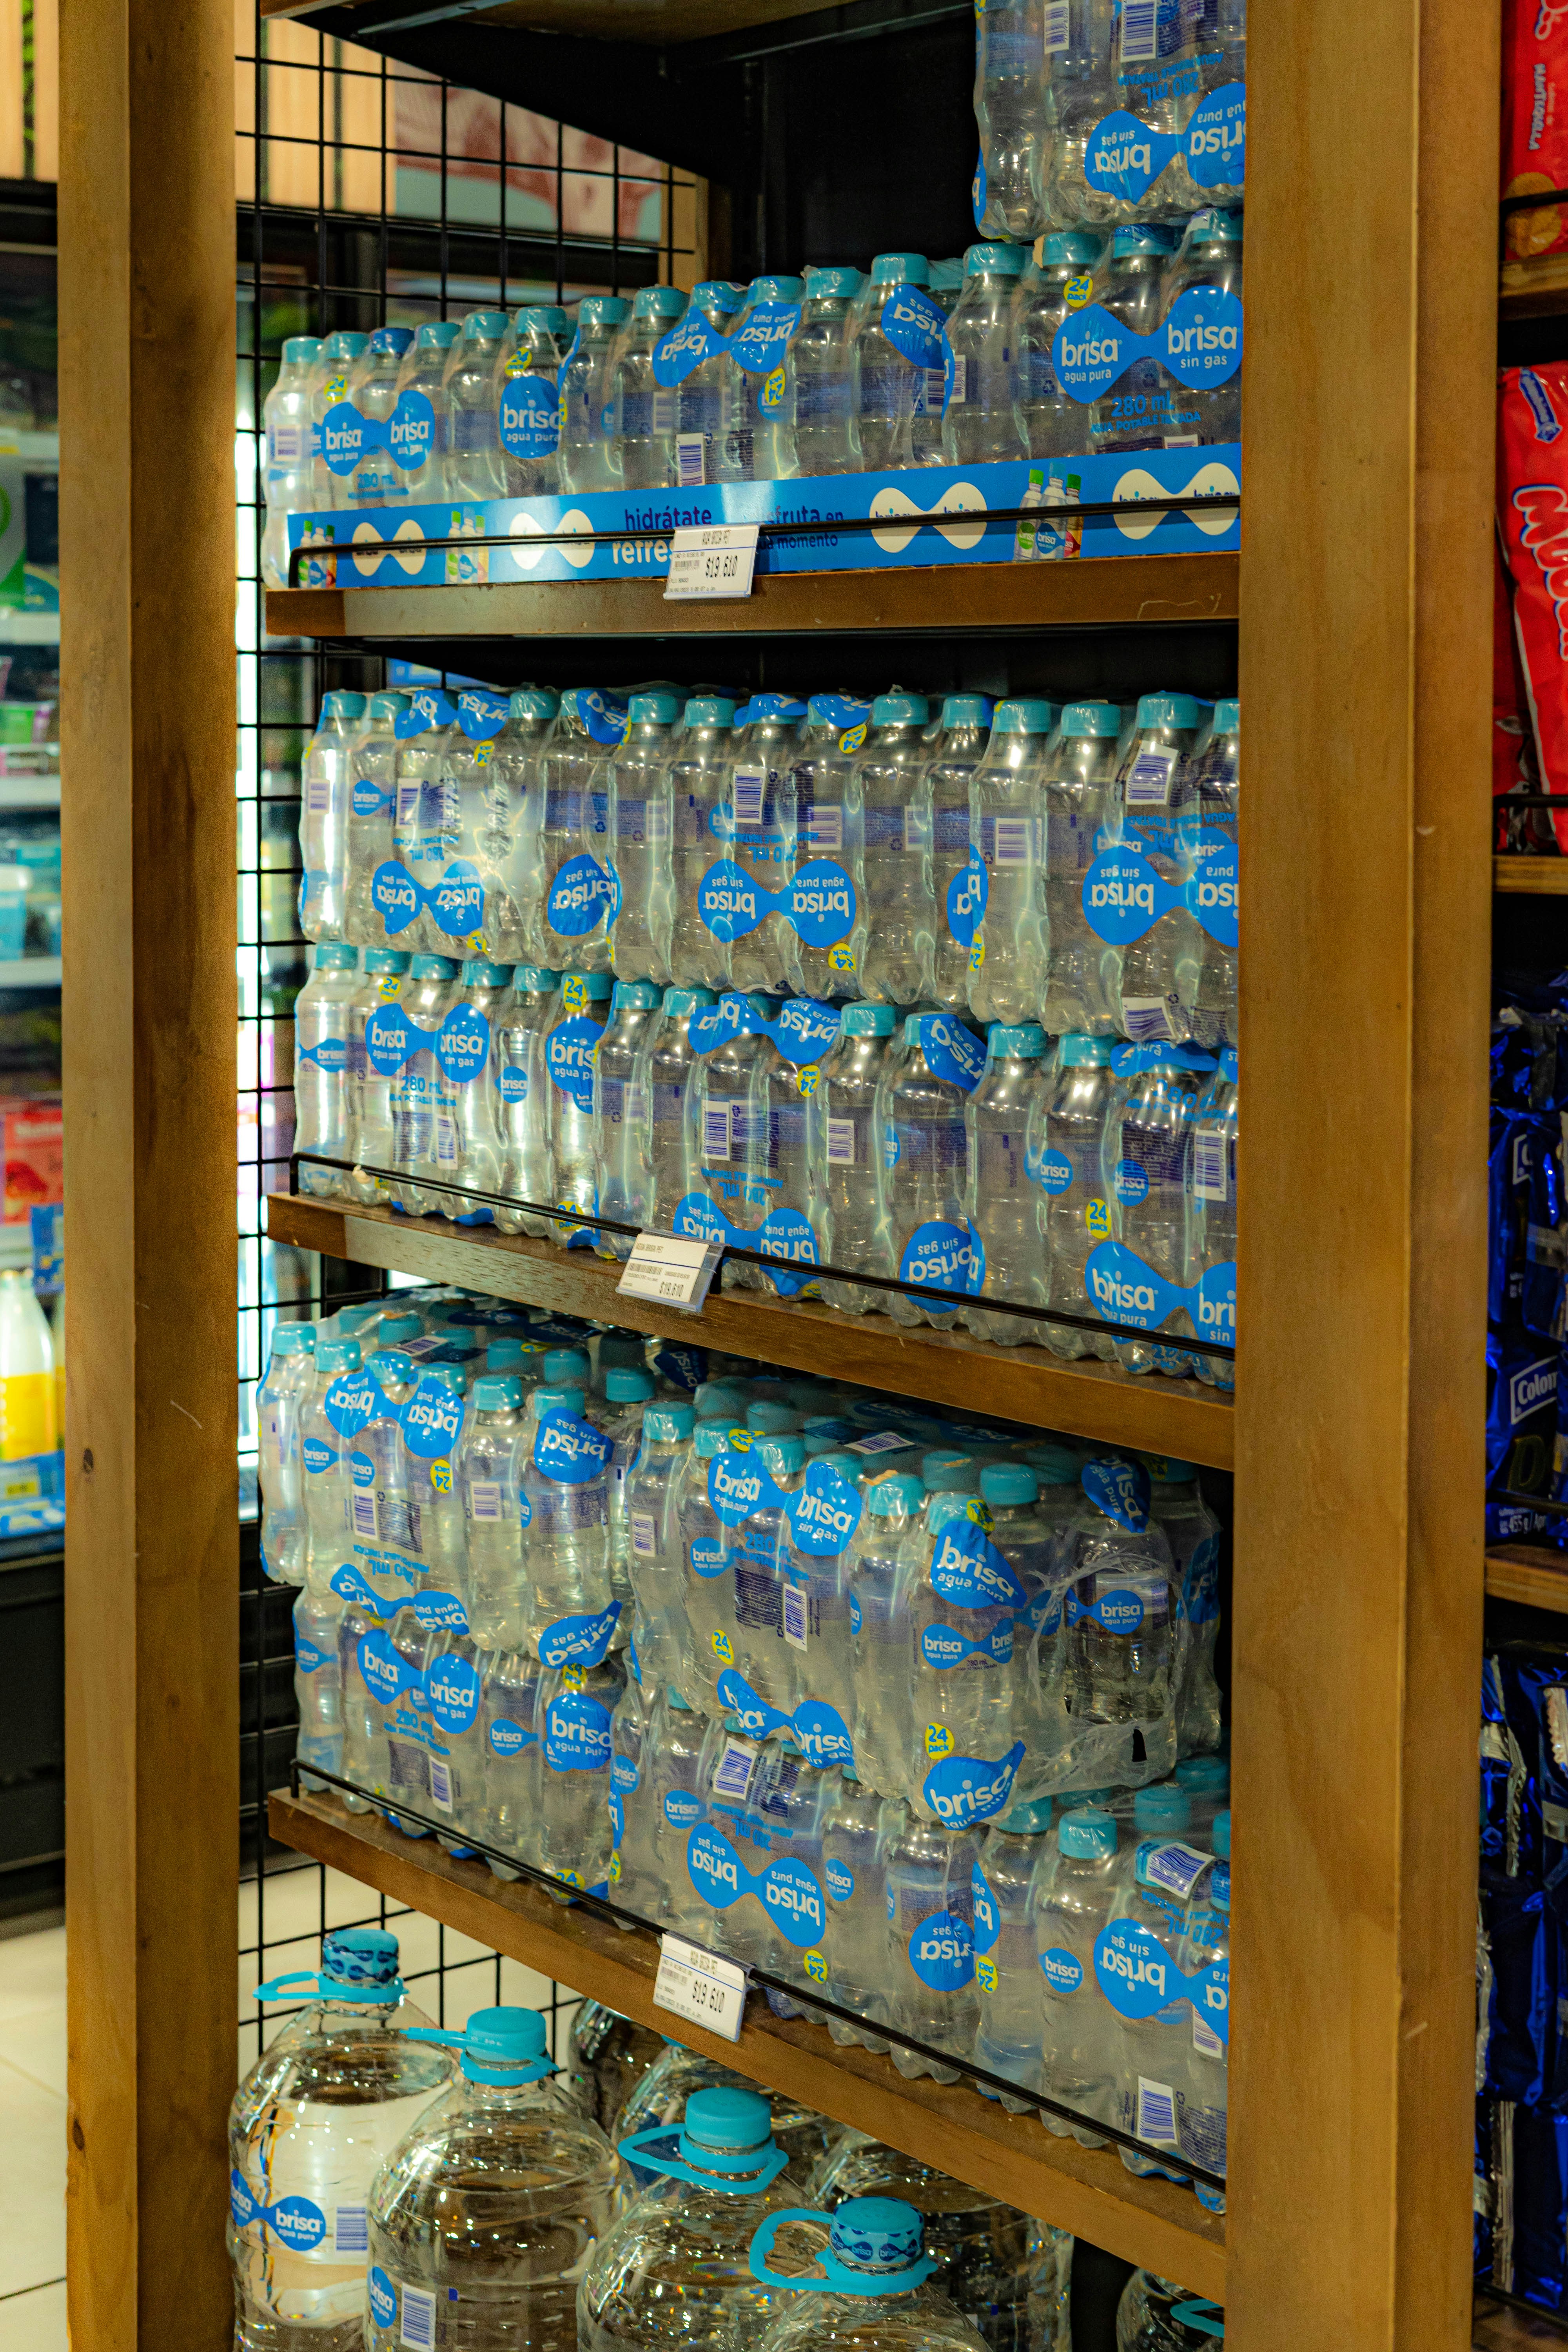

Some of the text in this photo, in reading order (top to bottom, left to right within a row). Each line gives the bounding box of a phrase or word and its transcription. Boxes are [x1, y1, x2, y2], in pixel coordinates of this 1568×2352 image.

[1141, 82, 1168, 107] mL
[1198, 110, 1223, 123] pura
[1102, 131, 1135, 146] sin gas
[1191, 120, 1244, 162] risa
[1094, 144, 1151, 183] brisa
[1069, 278, 1090, 292] 24
[892, 303, 942, 346] risa
[1168, 315, 1238, 355] brisa
[740, 321, 793, 350] brisa
[1062, 332, 1118, 368] brisa
[1180, 354, 1227, 369] sin gas
[1064, 368, 1112, 383] agua pura
[1111, 390, 1175, 417] 280 mL
[391, 414, 430, 443] brisa
[1116, 415, 1158, 431] POTABLE
[326, 423, 361, 450] brisa
[507, 432, 559, 443] agua pura
[624, 506, 711, 530] hidrátate
[826, 511, 844, 521] en
[777, 532, 838, 549] momento
[586, 691, 628, 732] isa
[750, 846, 771, 862] mL
[1101, 865, 1139, 880] sin gas
[1206, 866, 1234, 877] pura
[711, 878, 742, 888] sin gas
[796, 878, 845, 889] agua pura
[377, 884, 416, 912] brisa
[436, 887, 481, 916] brisa
[705, 893, 755, 920] brisa
[793, 892, 849, 921] brisa
[1092, 883, 1154, 917] brisa
[568, 979, 583, 995] 24
[372, 1023, 405, 1048] brisa
[782, 1008, 837, 1042] brisa
[551, 1037, 593, 1066] bris
[931, 1020, 982, 1079] risa
[458, 1056, 474, 1067] gas
[501, 1076, 527, 1090] brisa
[555, 1068, 579, 1079] agua
[1089, 1203, 1107, 1220] 24
[788, 1226, 809, 1237] agua
[918, 1243, 937, 1255] gas
[1093, 1268, 1154, 1311] brisa
[1120, 1312, 1147, 1326] pura
[1199, 1291, 1236, 1327] bri
[1210, 1329, 1230, 1341] sin
[408, 1402, 459, 1437] brisa
[556, 1417, 577, 1432] gas
[543, 1427, 605, 1461] brisa
[435, 1474, 450, 1490] 24
[714, 1464, 762, 1501] brisa
[796, 1488, 852, 1533] brisa
[1105, 1486, 1122, 1514] pura
[745, 1532, 775, 1553] 280
[798, 1523, 838, 1543] sin gas
[693, 1548, 726, 1563] brisa
[940, 1536, 1016, 1598] brisa
[937, 1572, 1005, 1602] agua pura
[1101, 1603, 1141, 1617] brisa
[552, 1632, 575, 1646] gas
[715, 1632, 729, 1647] 24
[924, 1635, 962, 1652] brisa
[363, 1646, 398, 1682] brisa
[431, 1677, 475, 1708] brisa
[492, 1729, 523, 1743] brisa
[928, 1725, 948, 1742] 24
[555, 1741, 581, 1753] agua
[929, 1743, 949, 1753] pack
[930, 1764, 1013, 1817] brisa
[666, 1799, 698, 1815] brisa
[698, 1838, 710, 1850] gas
[692, 1849, 737, 1889] brisa
[771, 1871, 817, 1892] agua pura
[766, 1881, 820, 1926] brisa
[933, 1926, 951, 1936] gas
[1165, 1915, 1224, 1949] mL 280
[920, 1940, 974, 1968] risa
[1111, 1935, 1149, 1956] sin gas
[809, 1963, 824, 1982] 24
[1045, 1959, 1079, 1978] brisa
[1101, 1947, 1166, 1996] brisa
[275, 2210, 321, 2232] brisa
